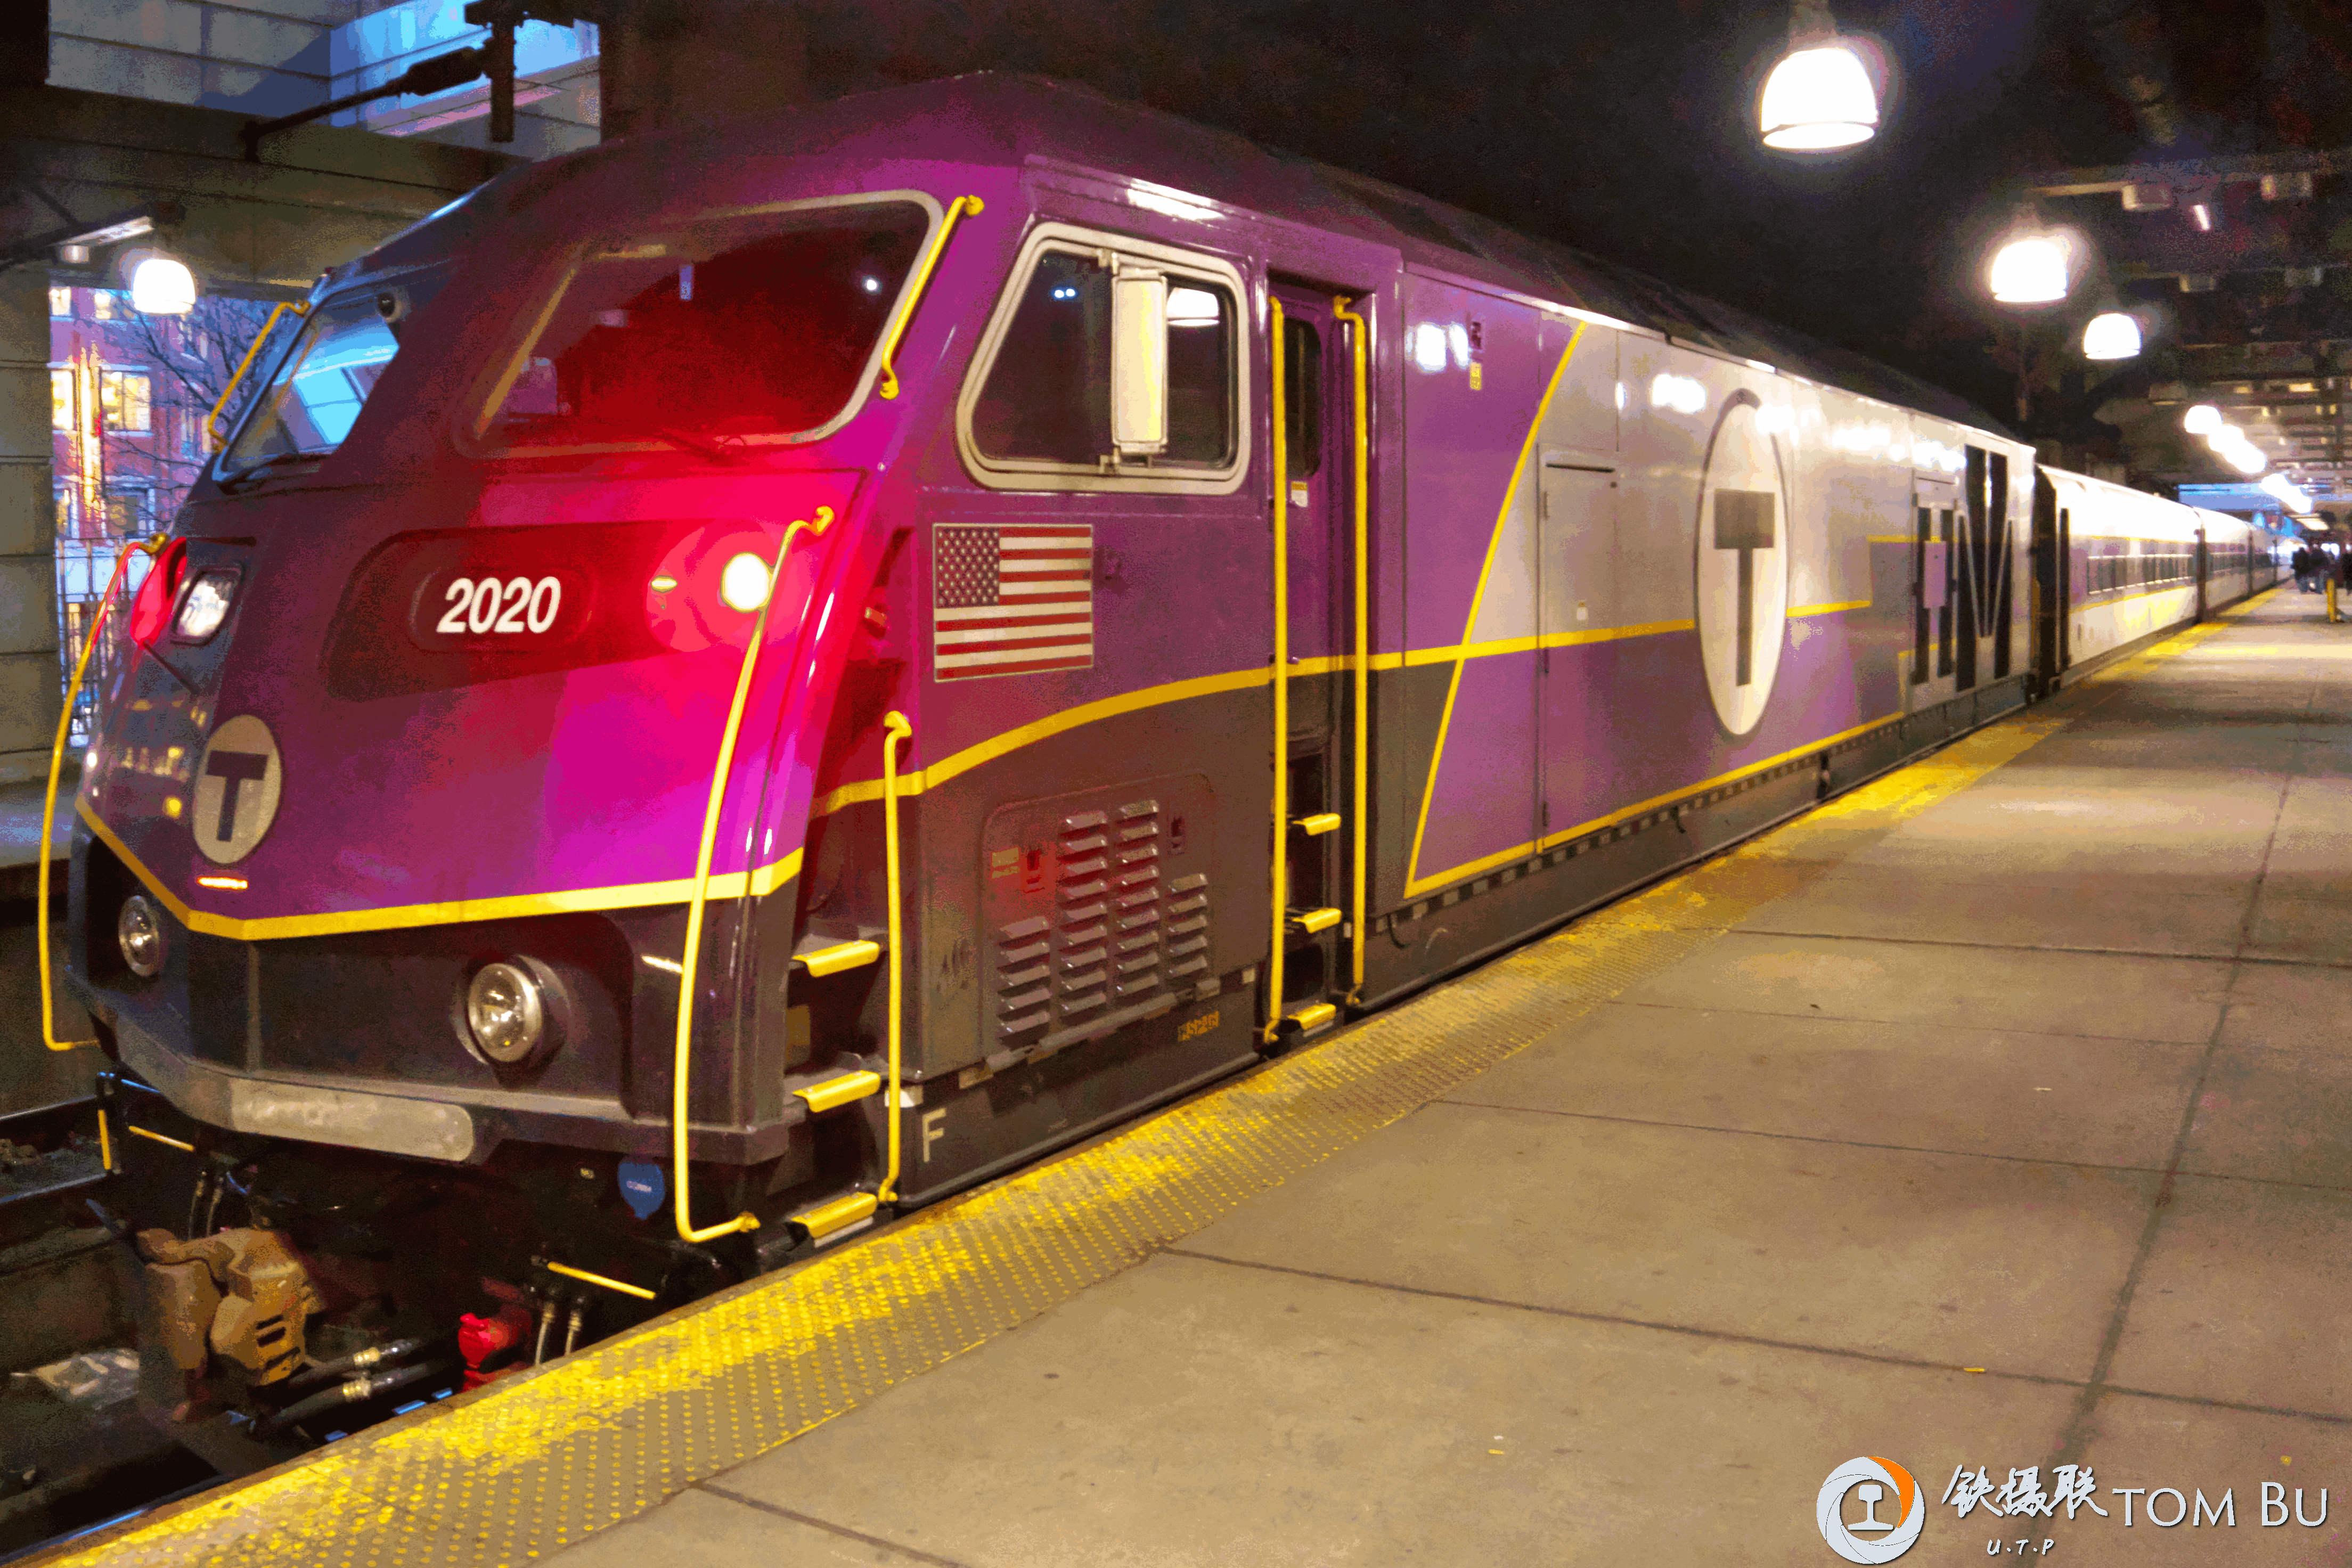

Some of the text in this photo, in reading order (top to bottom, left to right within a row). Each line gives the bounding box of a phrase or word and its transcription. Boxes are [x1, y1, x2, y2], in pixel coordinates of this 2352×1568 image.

[436, 576, 561, 634] 2020
[1713, 488, 1776, 687] T
[205, 750, 269, 842] T
[922, 1108, 946, 1162] F
